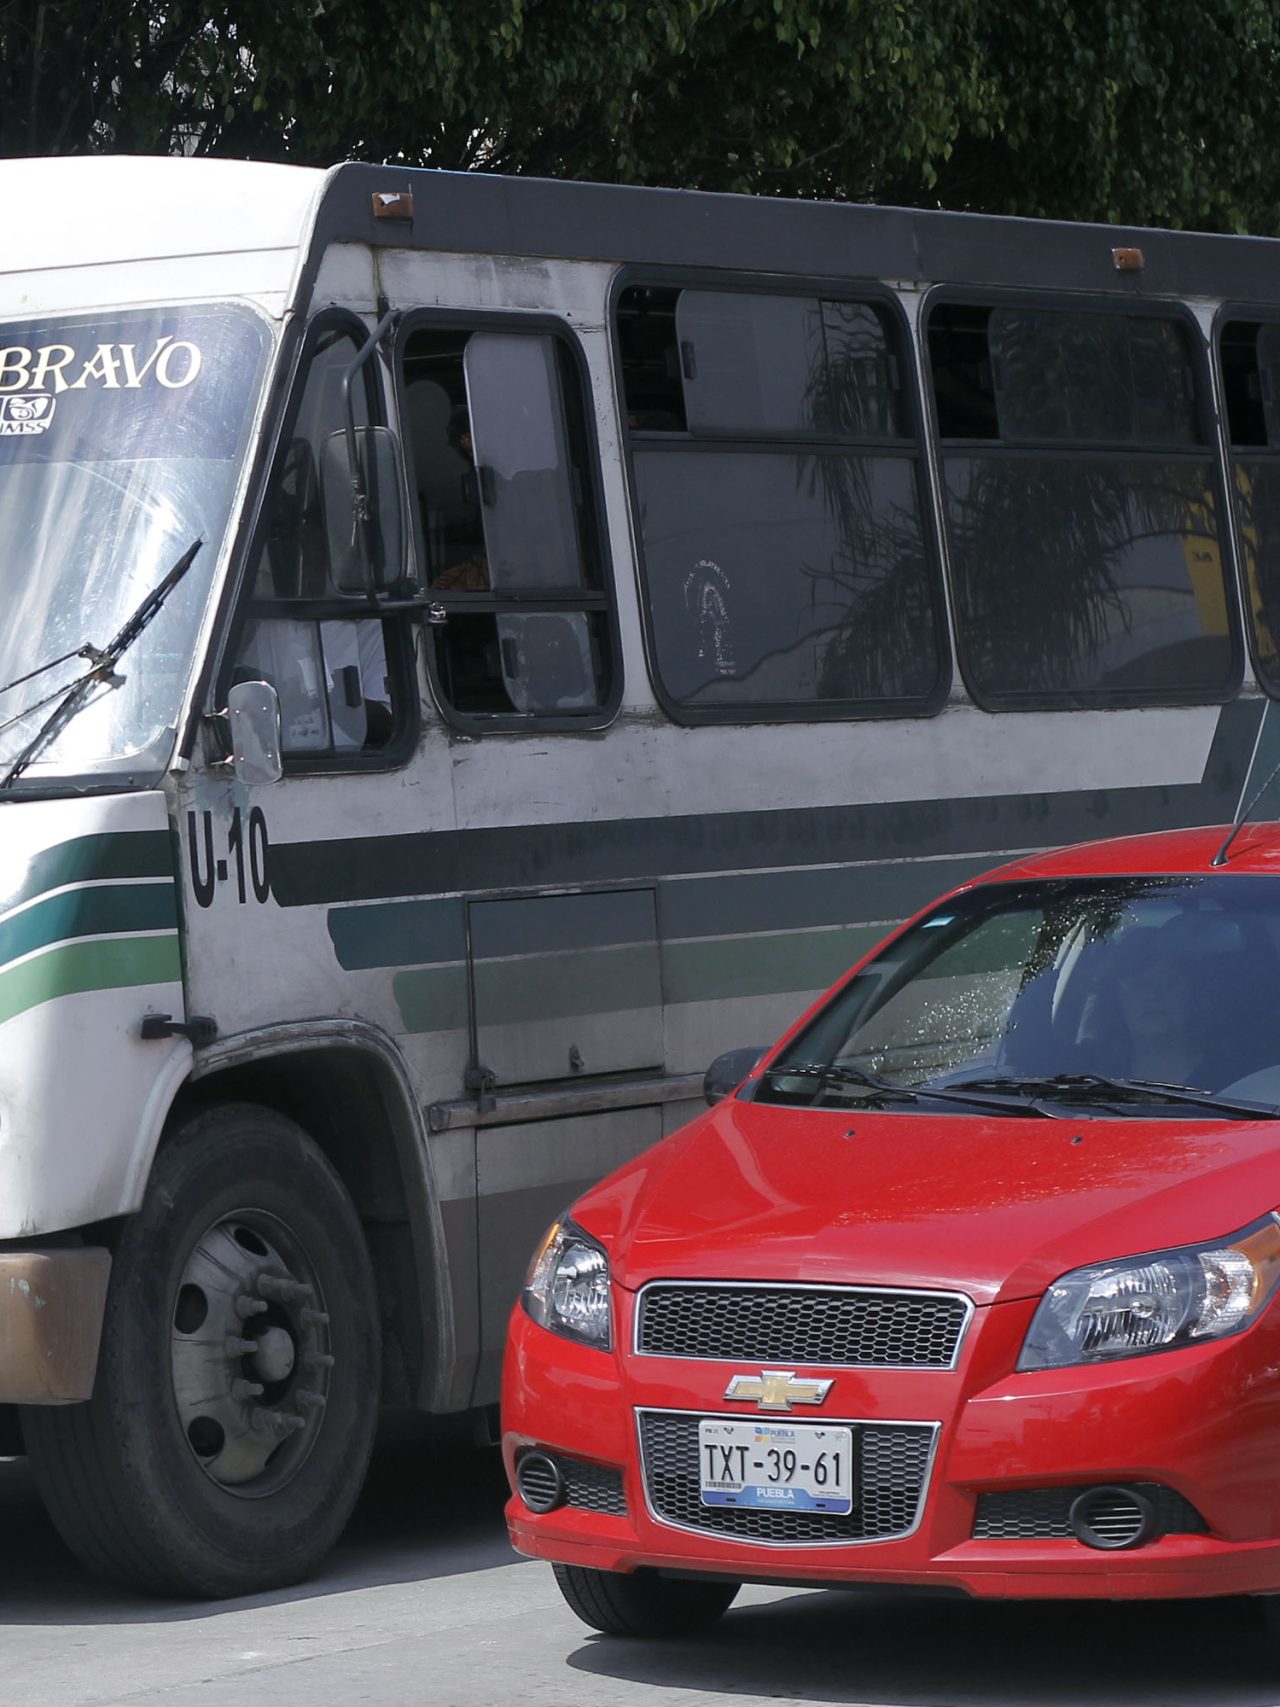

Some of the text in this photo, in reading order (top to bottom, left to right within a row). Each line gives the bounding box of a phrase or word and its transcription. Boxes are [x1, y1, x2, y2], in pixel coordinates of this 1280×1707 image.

[0, 422, 48, 435] IMSS
[770, 1429, 797, 1438] PUEBLA
[703, 1443, 841, 1488] TXT-39-61
[756, 1487, 795, 1500] PUEBLA
